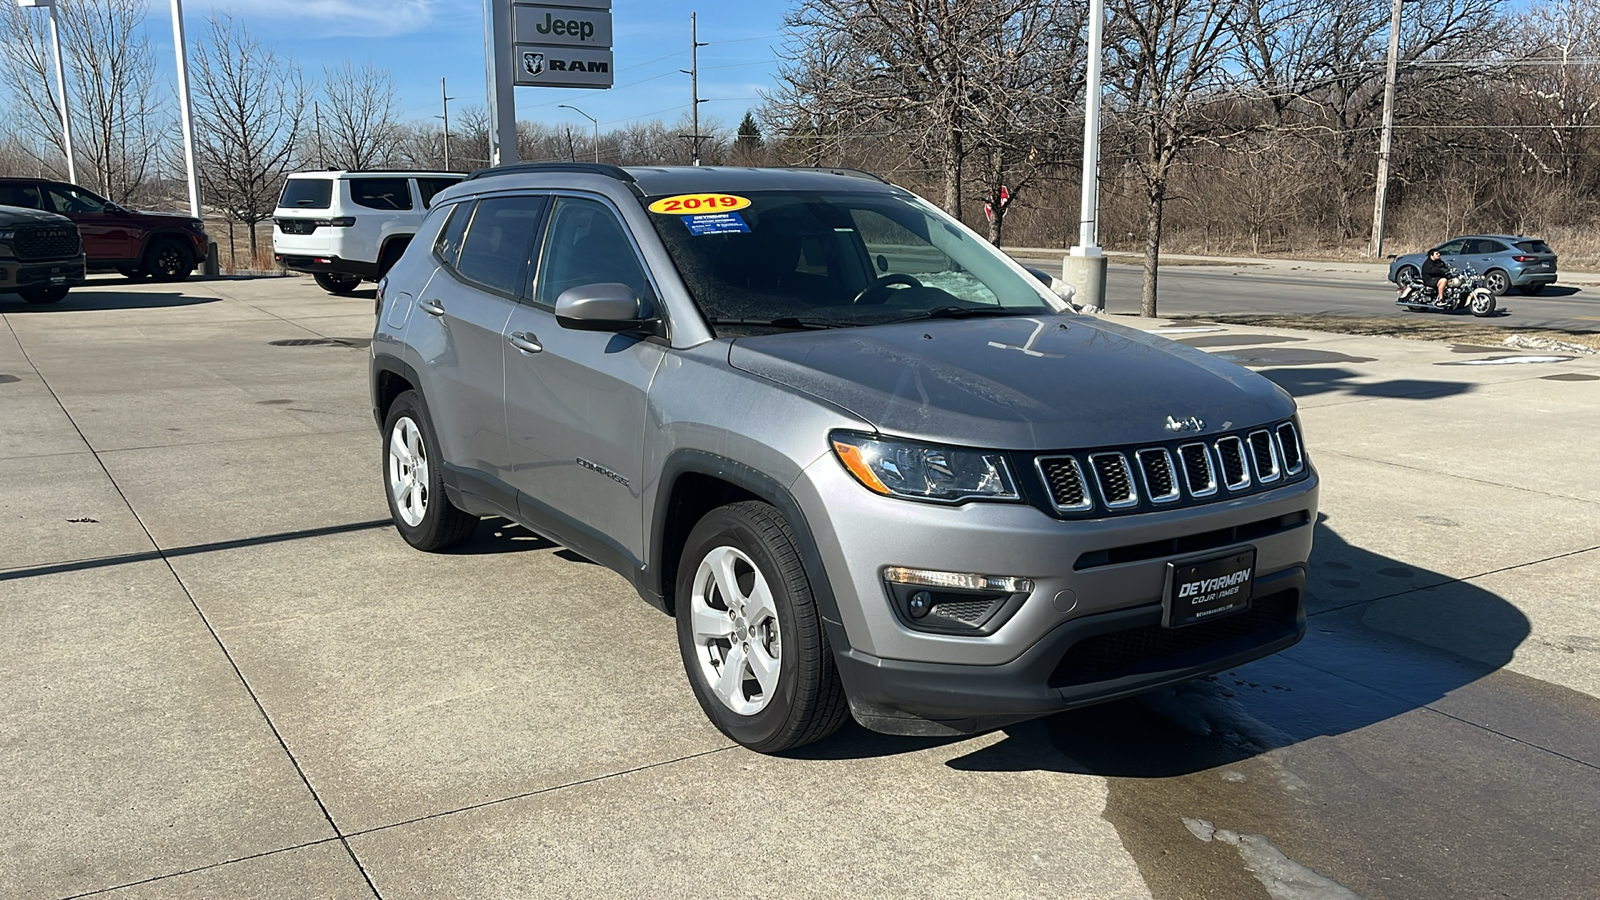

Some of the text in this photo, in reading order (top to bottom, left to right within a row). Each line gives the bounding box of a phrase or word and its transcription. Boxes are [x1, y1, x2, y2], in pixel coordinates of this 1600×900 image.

[536, 13, 594, 41] Jeep
[549, 59, 608, 73] RAM
[663, 196, 738, 212] 2019
[576, 457, 630, 488] COMPASS
[1178, 568, 1251, 598] DEYARMAN
[1218, 586, 1240, 599] AMES
